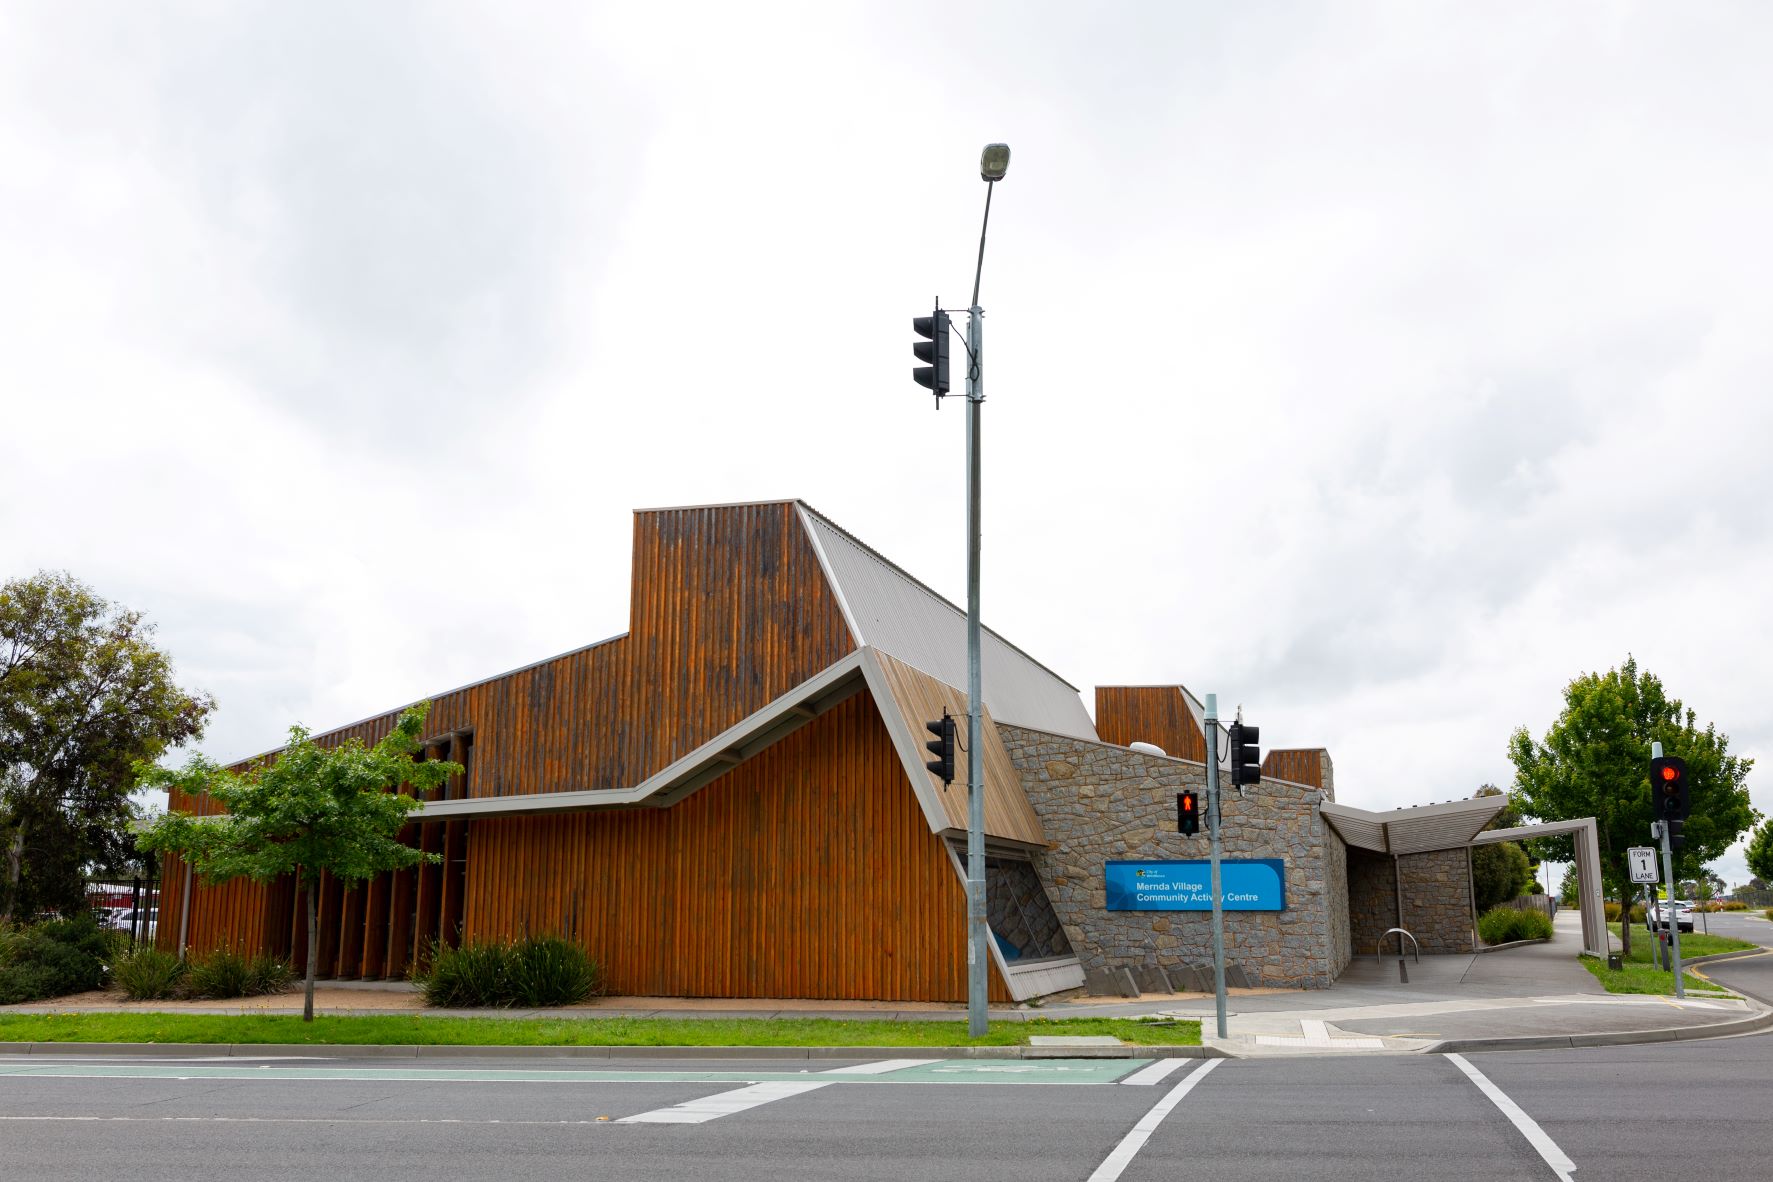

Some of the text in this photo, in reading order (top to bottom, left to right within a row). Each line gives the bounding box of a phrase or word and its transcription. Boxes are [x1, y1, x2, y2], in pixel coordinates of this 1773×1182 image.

[1641, 859, 1646, 870] 1
[1136, 882, 1203, 892] Mernda Village
[1136, 893, 1259, 903] Community Activy Centre
